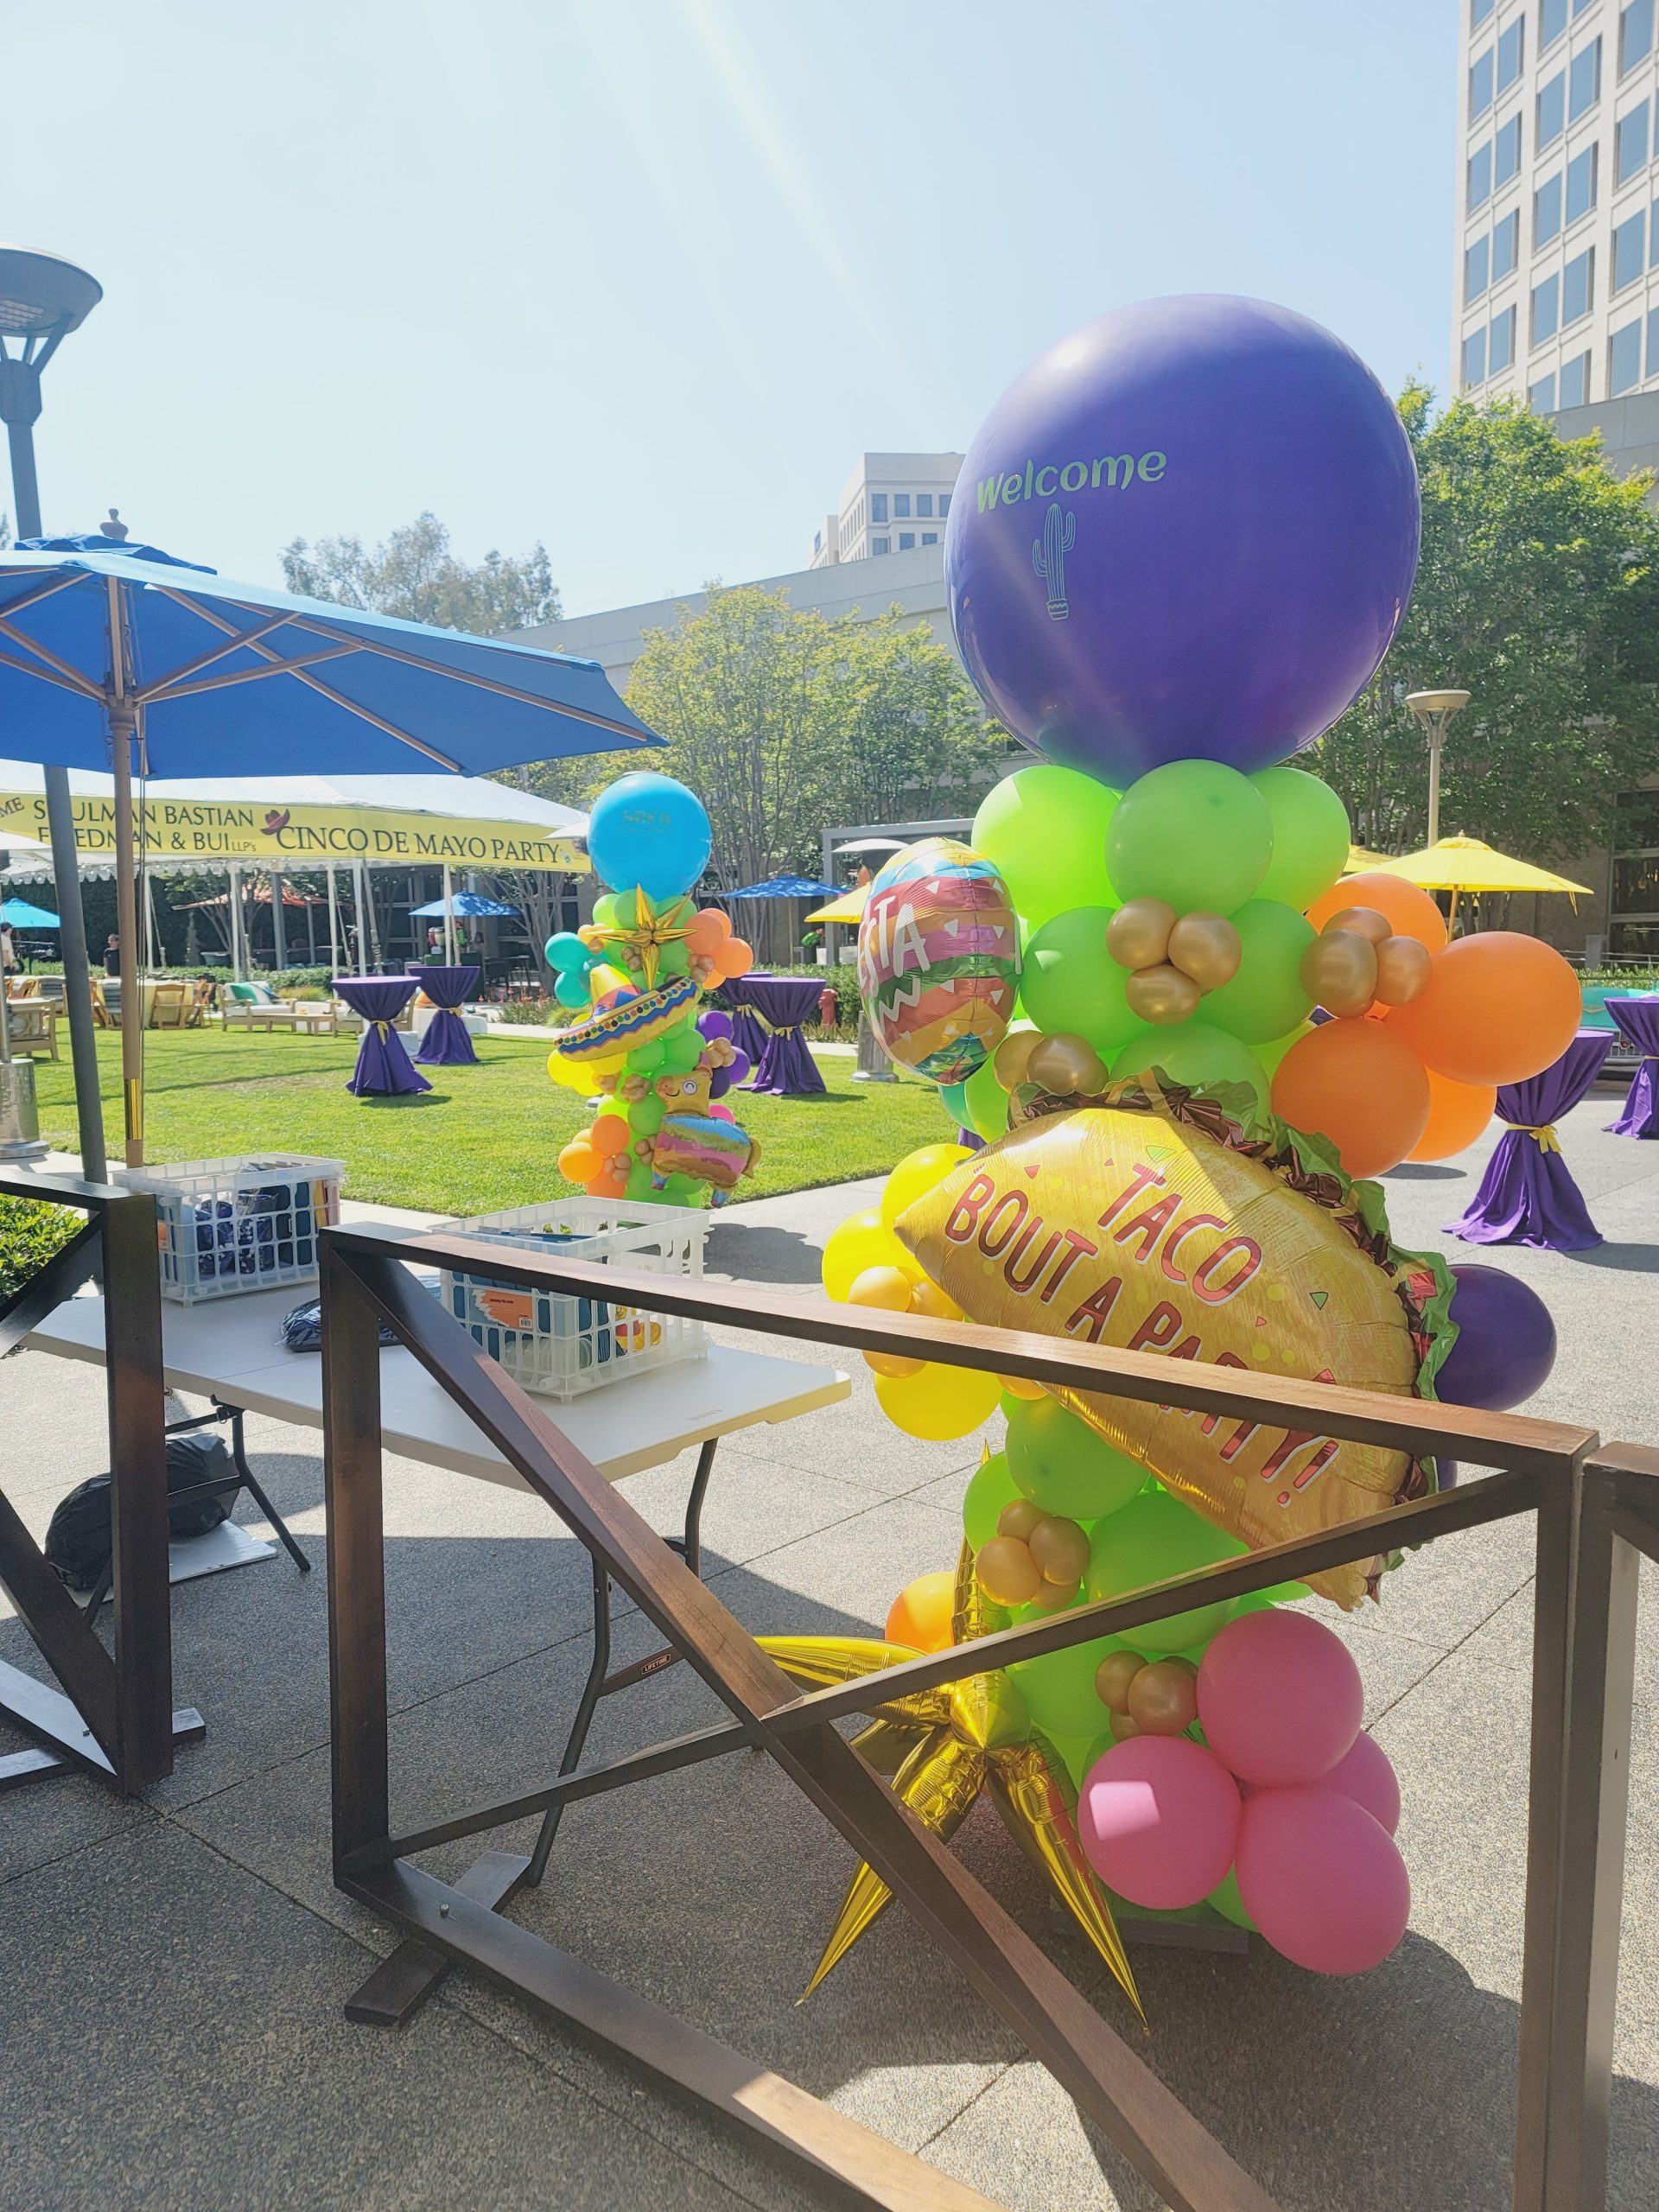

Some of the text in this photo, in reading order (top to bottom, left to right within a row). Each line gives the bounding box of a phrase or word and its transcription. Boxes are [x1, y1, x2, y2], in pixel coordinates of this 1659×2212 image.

[165, 805, 254, 827] BASTIAN
[170, 831, 187, 850] &
[193, 832, 230, 851] BUI
[276, 826, 559, 863] CINCO DE MAYO PARTY
[1096, 1163, 1262, 1306] TACO
[1064, 1276, 1122, 1344] A
